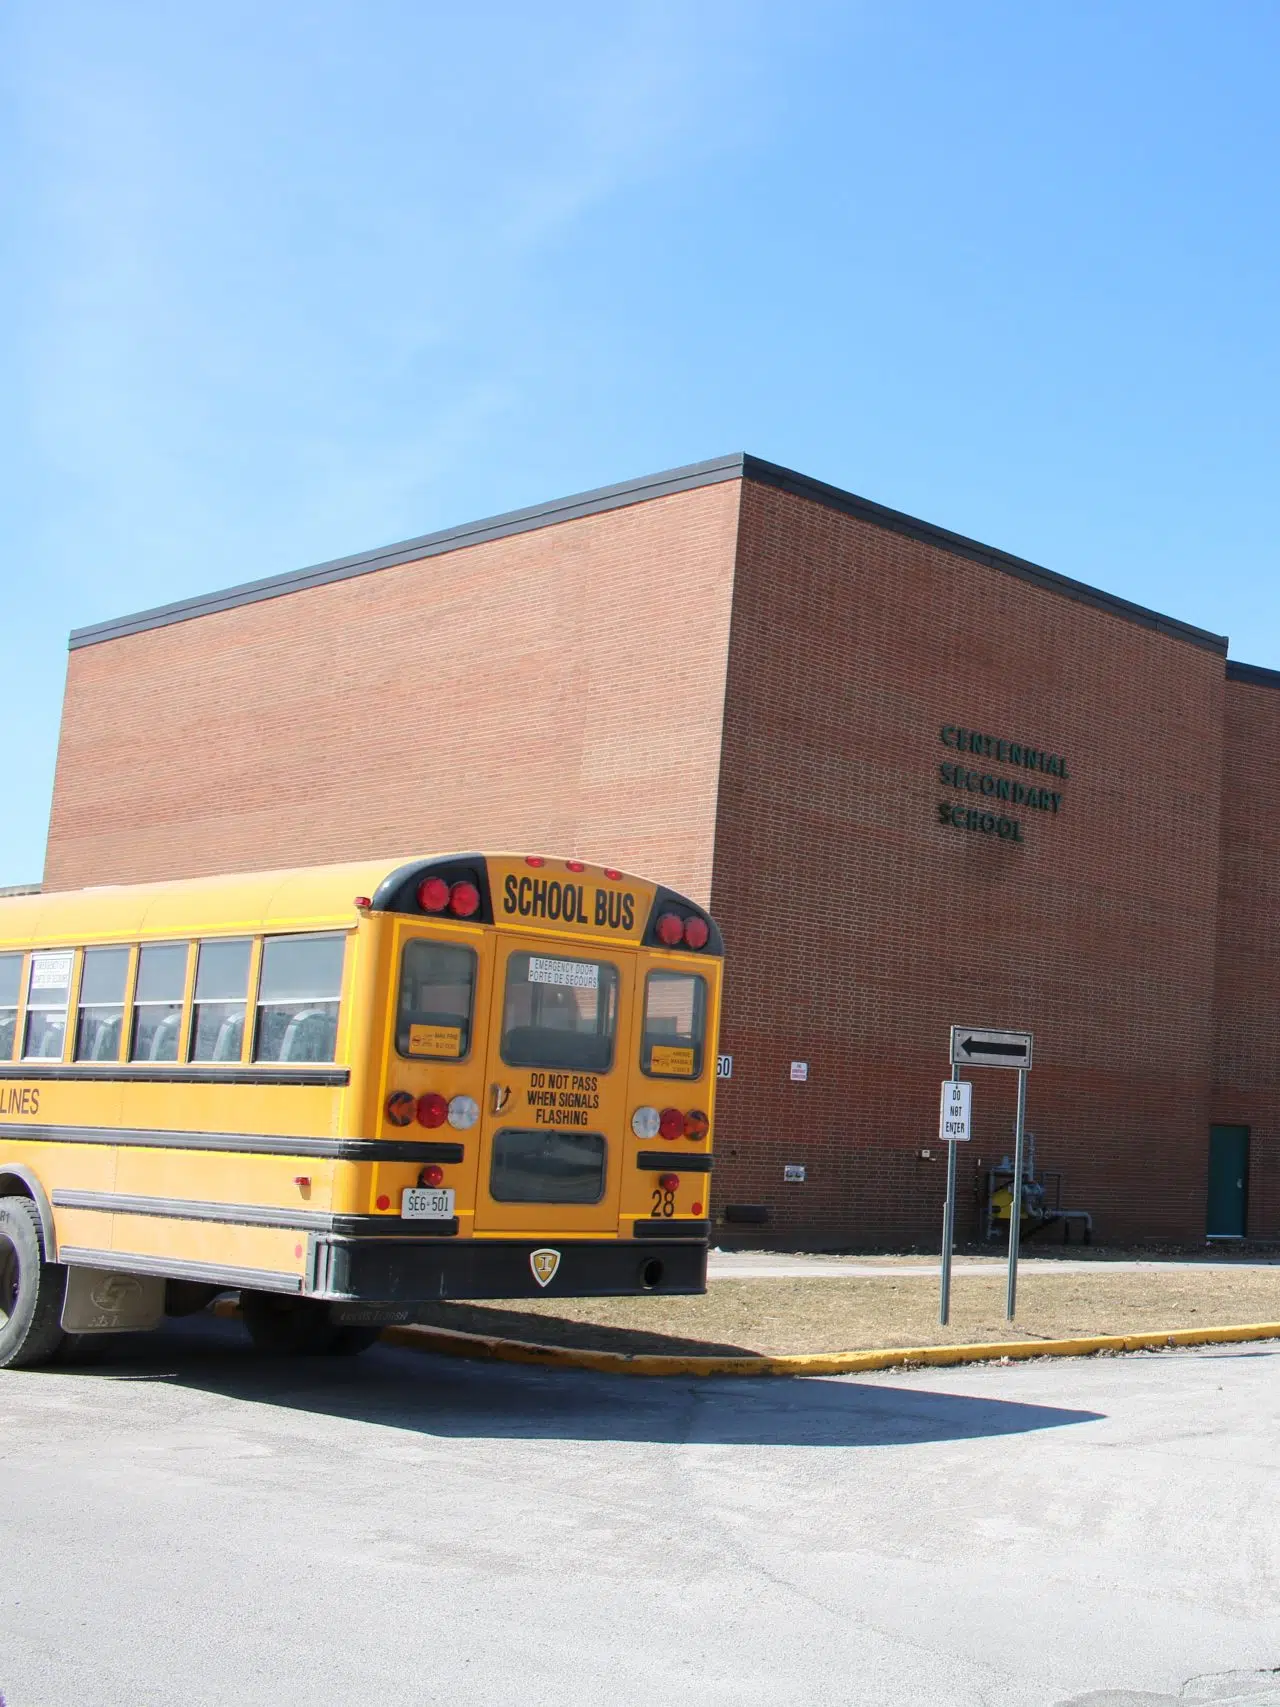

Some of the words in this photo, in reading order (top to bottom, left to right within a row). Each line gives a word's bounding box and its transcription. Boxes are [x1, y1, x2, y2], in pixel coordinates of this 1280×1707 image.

[941, 723, 1071, 779] CENTENNIAL
[940, 762, 1064, 814] SECONDARY
[938, 801, 1024, 842] SCHOOL
[503, 874, 588, 924] SCHOOL
[594, 888, 635, 931] BUS
[534, 959, 574, 974] EMERGENCY
[576, 964, 593, 976] DOOR
[529, 970, 552, 982] PORTE
[554, 973, 563, 983] DE
[565, 974, 597, 988] SECOURS
[530, 1072, 545, 1088] DO
[548, 1074, 569, 1089] NOT
[571, 1075, 598, 1091] PASS
[0, 1088, 40, 1115] LINES
[527, 1090, 556, 1106] WHEN
[558, 1092, 599, 1109] SIGNALS
[953, 1089, 961, 1101] DO
[535, 1108, 588, 1126] FLASHING
[950, 1105, 962, 1117] NOT
[945, 1121, 965, 1134] ENTER
[651, 1189, 675, 1217] 28
